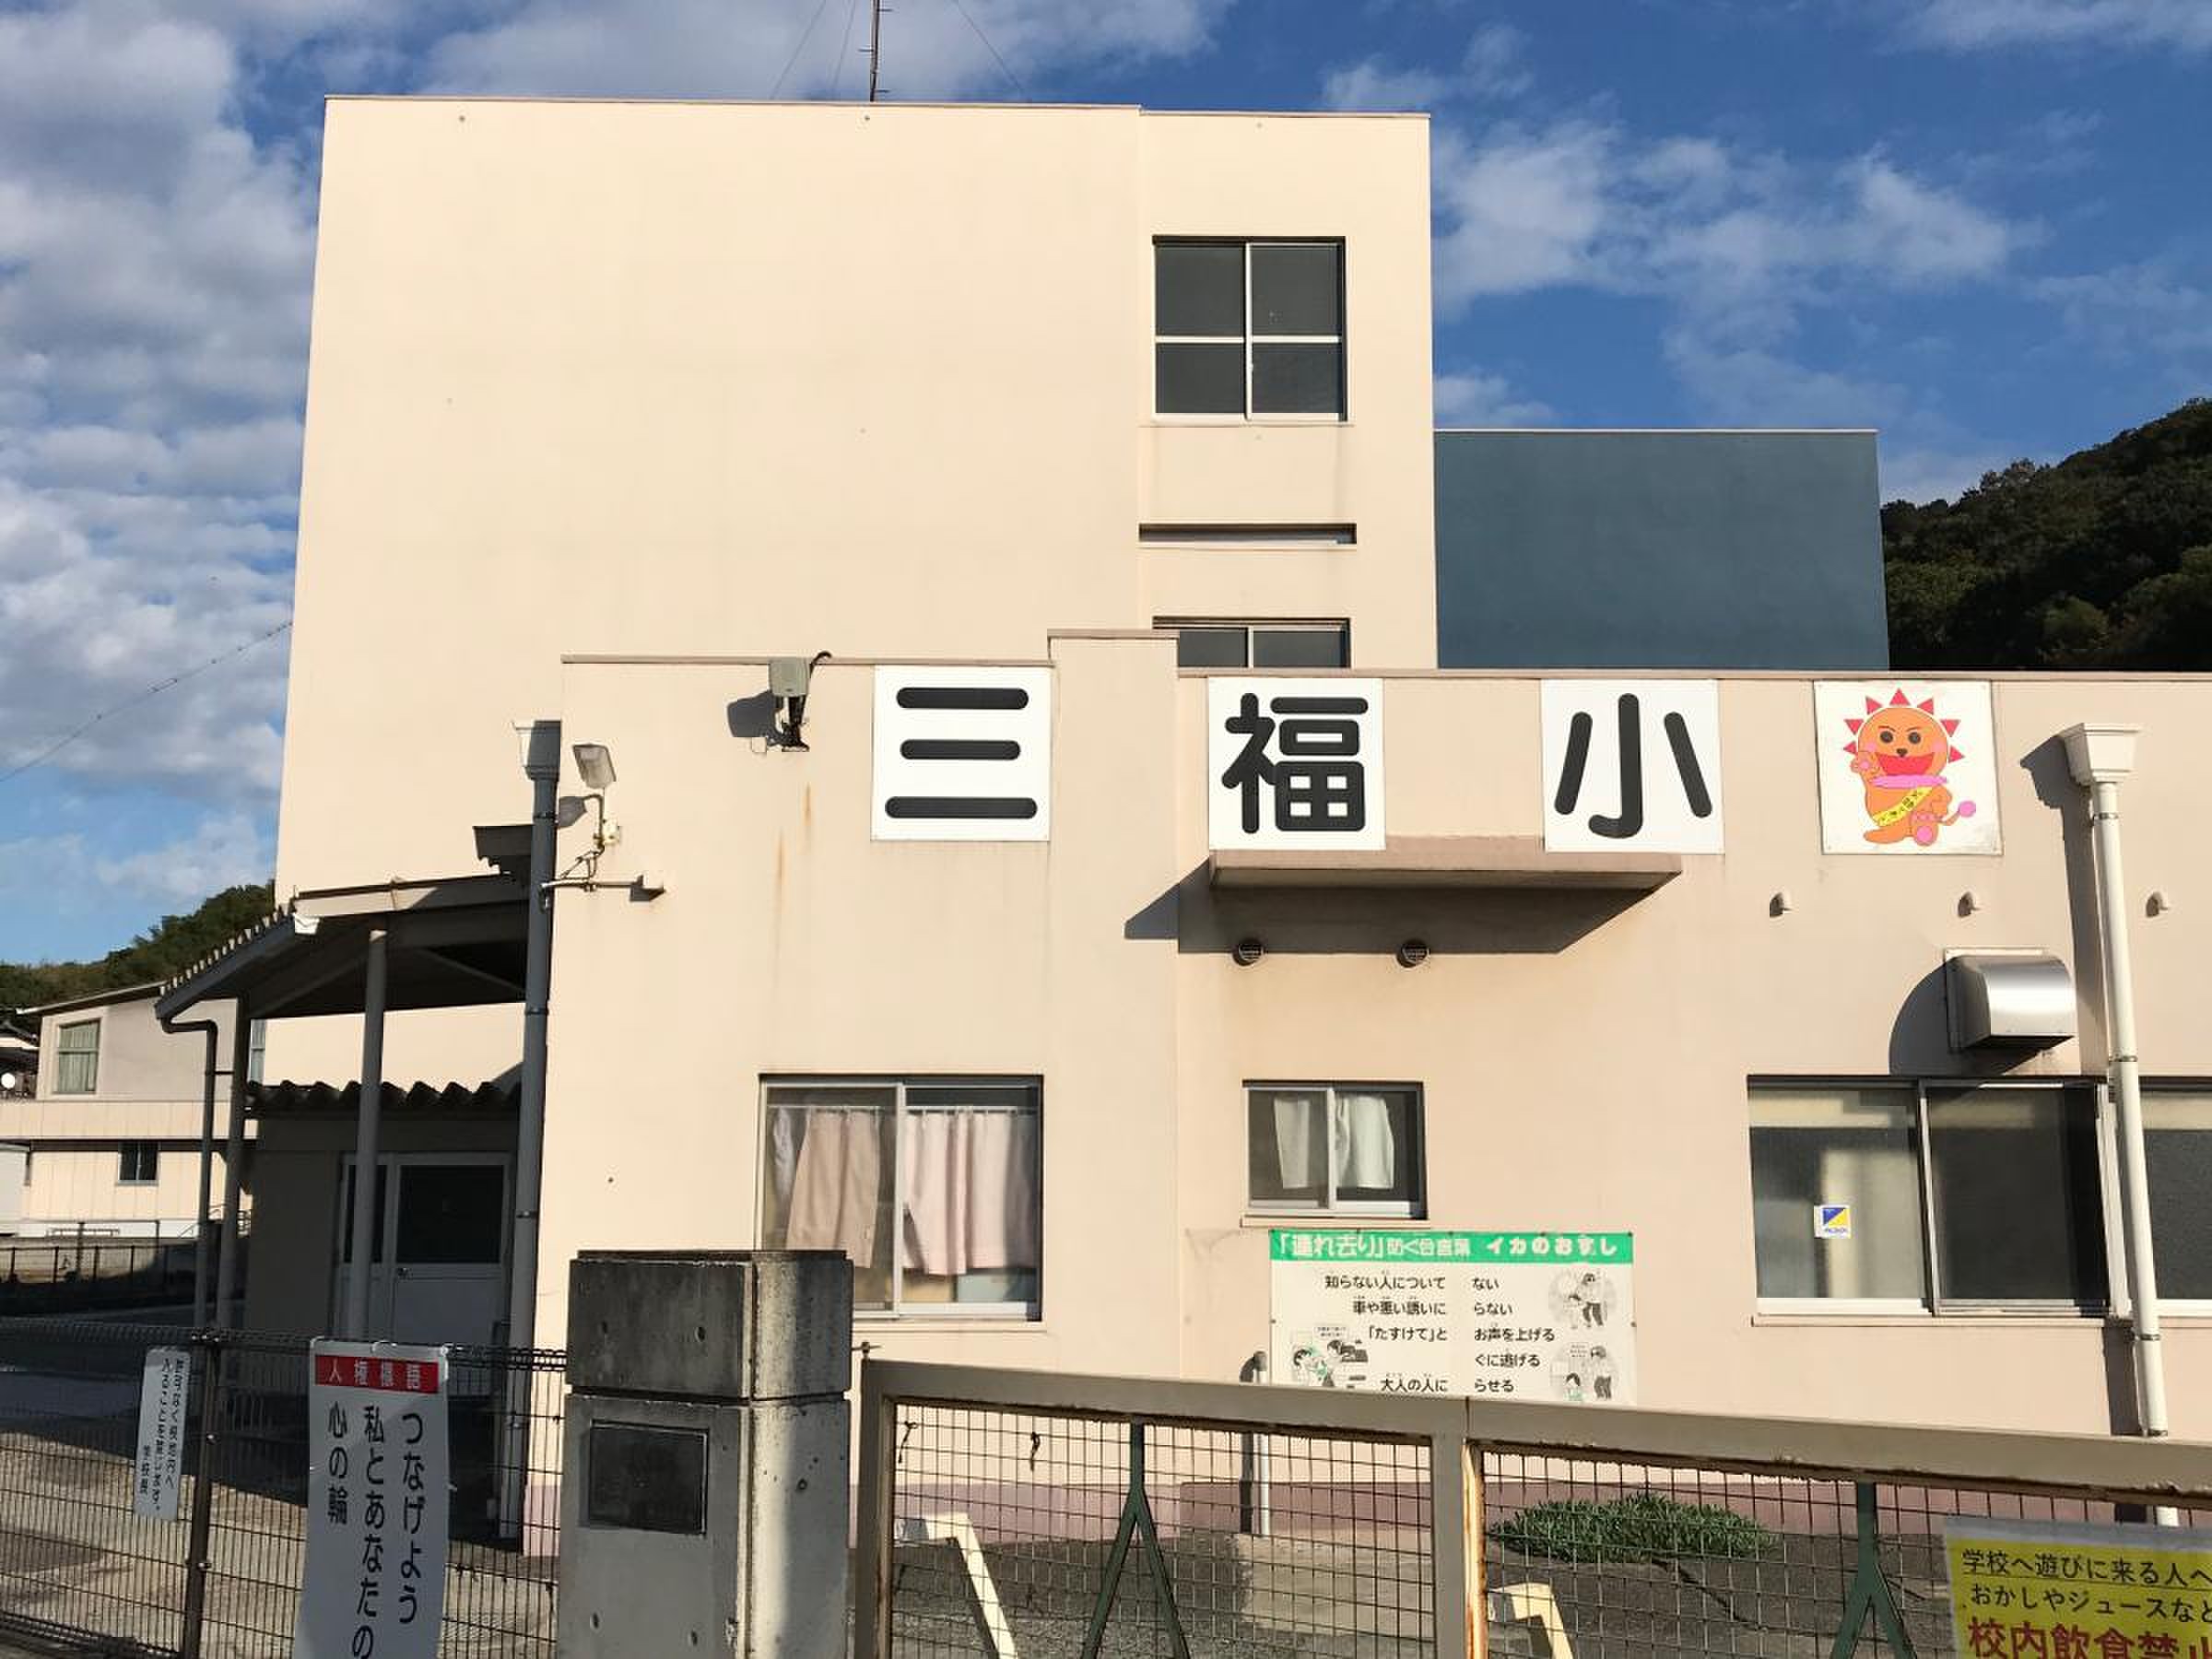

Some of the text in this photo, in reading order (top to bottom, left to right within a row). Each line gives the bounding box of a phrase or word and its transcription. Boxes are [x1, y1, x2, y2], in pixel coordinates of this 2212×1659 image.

[1487, 1236, 1618, 1256] イカのおすし
[1324, 1275, 1446, 1290] 知らない人について
[1369, 1325, 1448, 1342] 「たすけて」と
[1380, 1377, 1514, 1393] 大人の人に らせる
[326, 1400, 349, 1526] 心の輪
[352, 1404, 387, 1659] 私とあなたの
[398, 1411, 427, 1625] つなげよう
[1961, 1547, 2212, 1587] 学校へ遊びに来る人へ
